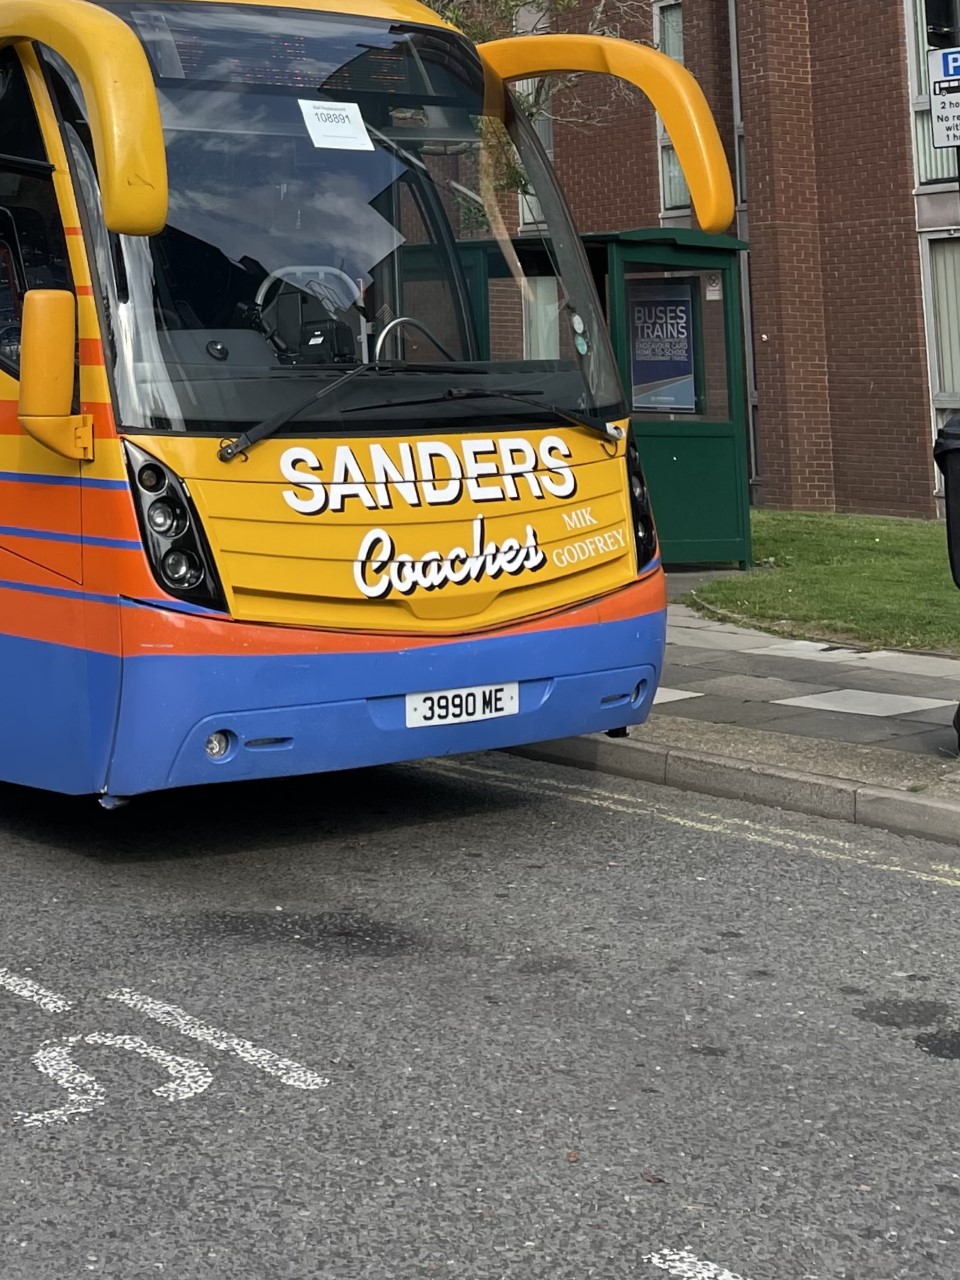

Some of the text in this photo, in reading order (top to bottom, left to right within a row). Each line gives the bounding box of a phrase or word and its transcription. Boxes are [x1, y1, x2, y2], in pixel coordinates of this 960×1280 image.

[948, 53, 960, 75] P
[940, 101, 946, 110] 2
[315, 112, 352, 125] 108891
[936, 114, 950, 123] No
[946, 133, 950, 142] 1
[635, 306, 687, 323] BUSES
[635, 323, 688, 338] TRAINS
[279, 435, 577, 515] SANDERS
[562, 507, 599, 531] MIK
[353, 514, 546, 599] Coaches
[552, 528, 626, 568] GODFREY
[422, 687, 504, 721] 3990 ME
